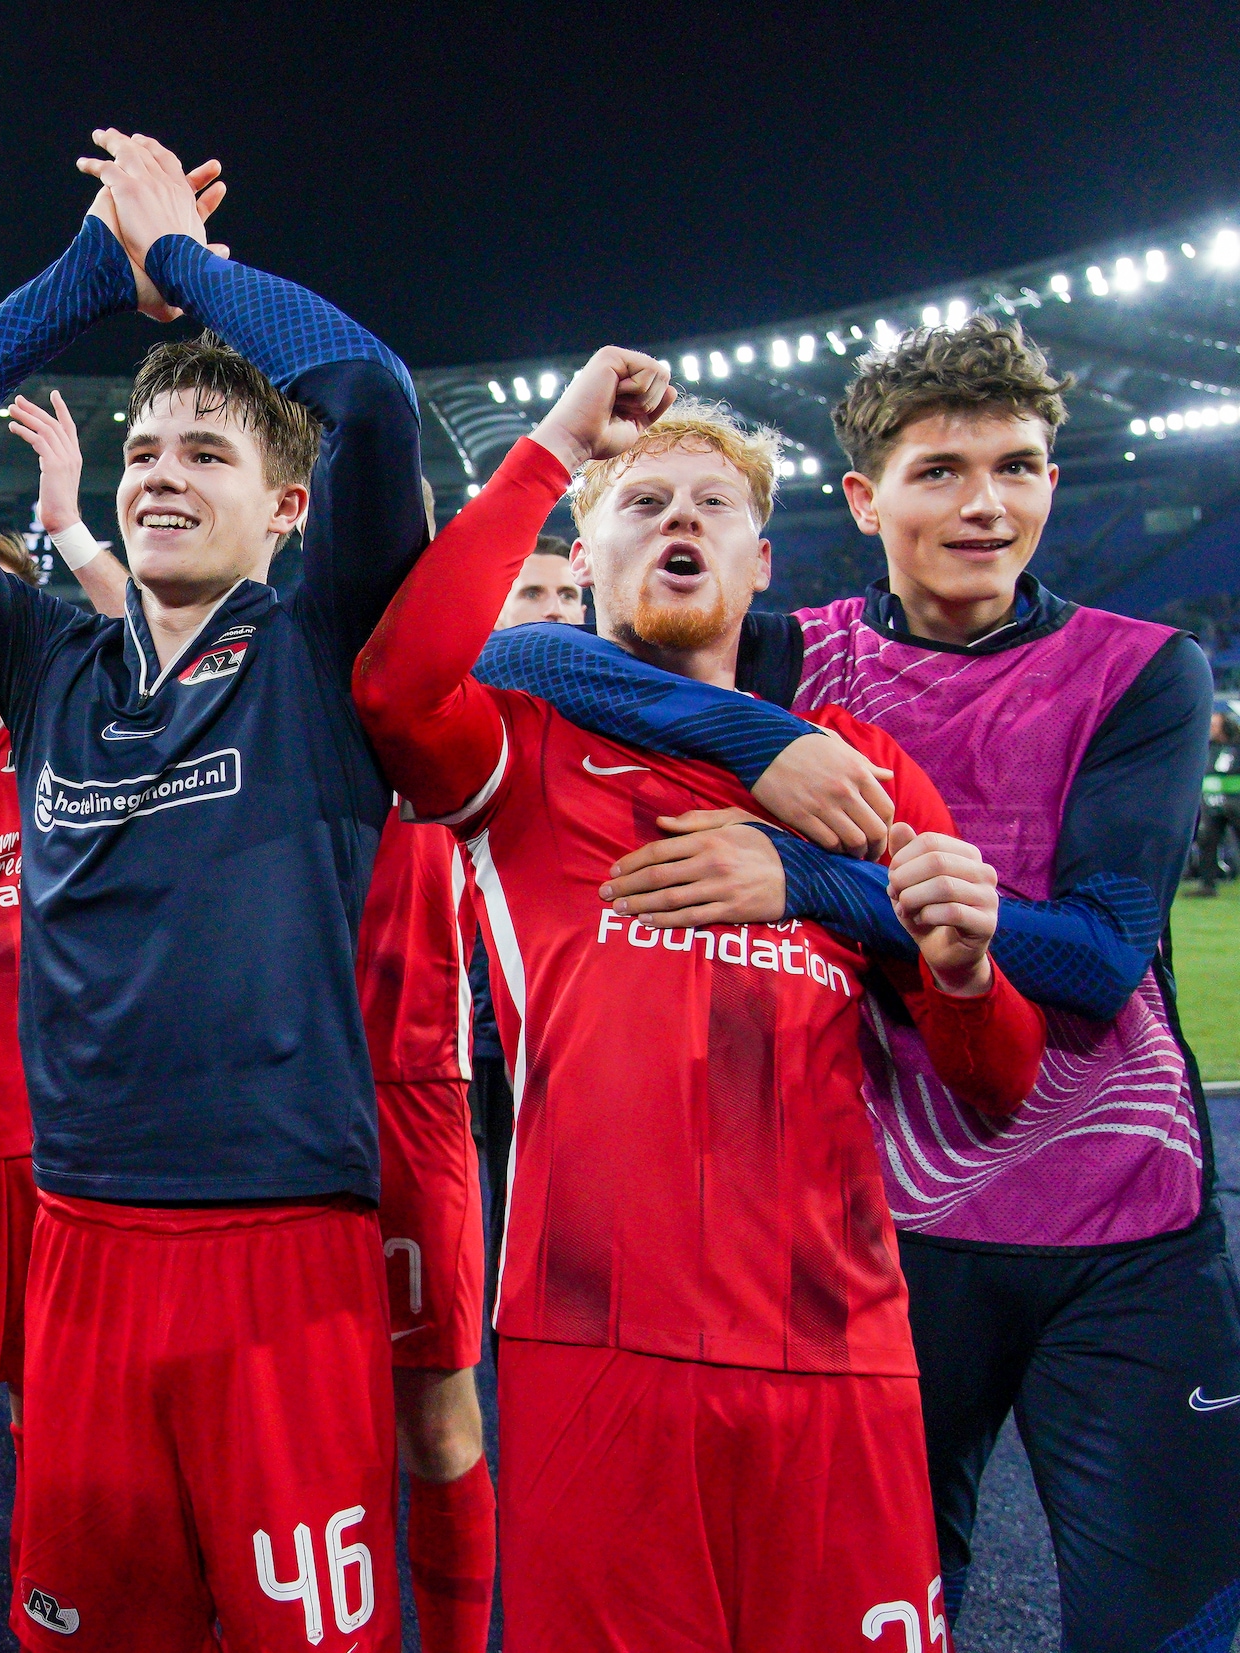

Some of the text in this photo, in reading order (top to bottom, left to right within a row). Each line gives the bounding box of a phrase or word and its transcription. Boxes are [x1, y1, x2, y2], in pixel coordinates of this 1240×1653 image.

[190, 649, 241, 680] AZ
[54, 761, 226, 815] hotelinegmond.nl
[597, 908, 851, 997] Foundation
[252, 1504, 376, 1647] 46
[27, 1588, 69, 1631] AZ
